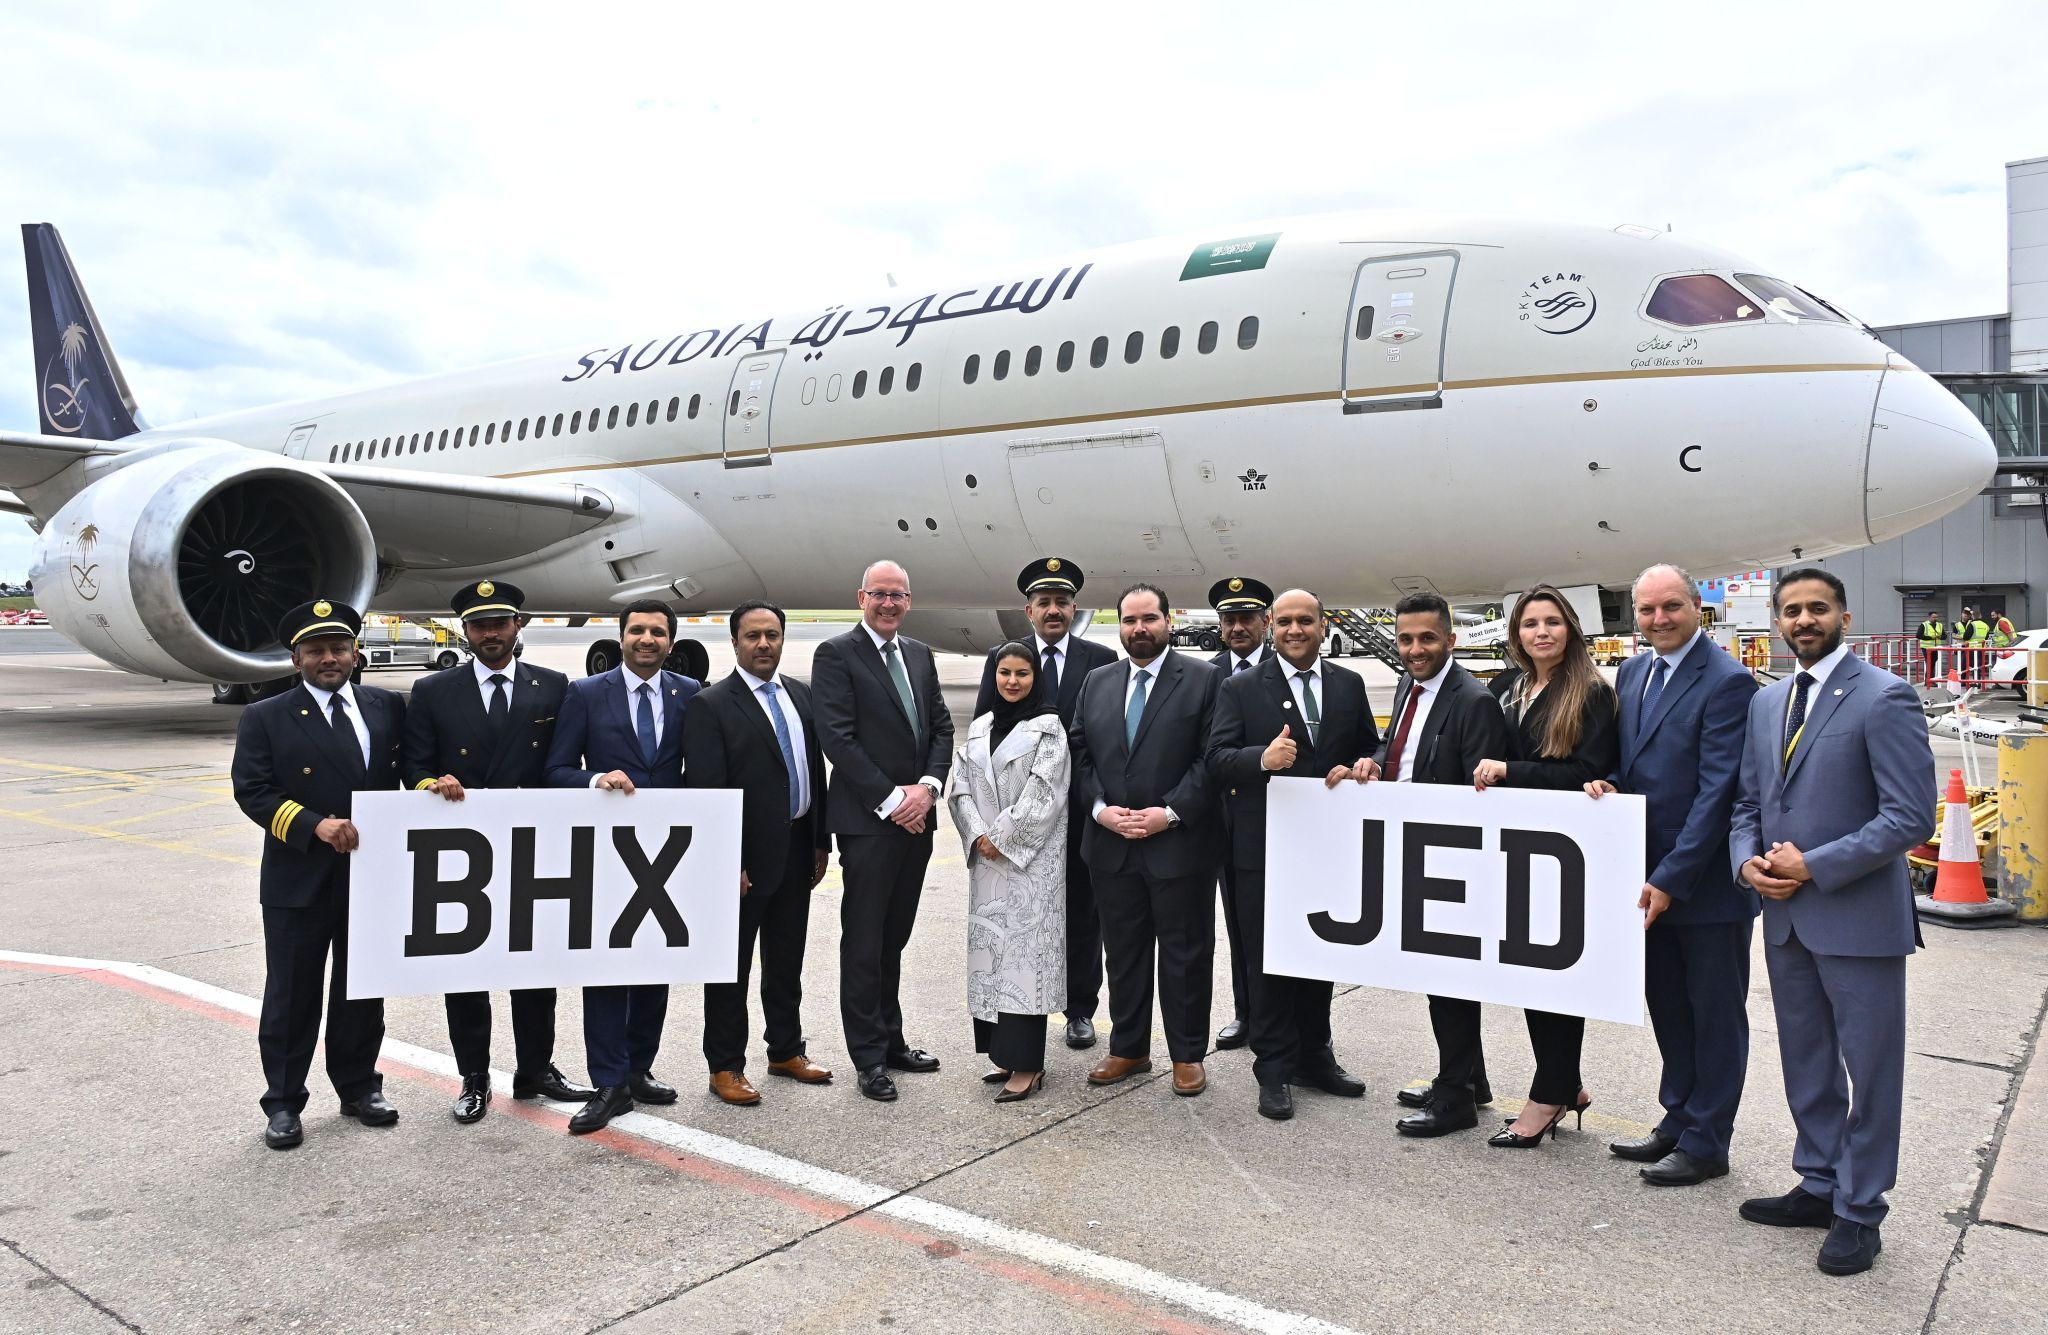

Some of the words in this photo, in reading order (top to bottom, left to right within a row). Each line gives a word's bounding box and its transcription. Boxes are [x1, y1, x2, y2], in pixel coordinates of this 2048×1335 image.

[1519, 272, 1583, 321] SKYTEAM
[789, 262, 1095, 363] السعودية
[561, 318, 774, 382] SAUDIA
[1677, 335, 1698, 353] الله
[1630, 357, 1653, 370] God
[1654, 357, 1680, 367] Bless
[1683, 356, 1703, 366] You
[1679, 445, 1702, 472] C
[1243, 482, 1267, 491] IATA
[1468, 631, 1484, 639] Next
[1951, 726, 1999, 741] ssport
[404, 825, 693, 957] BHX
[1307, 818, 1585, 971] JED
